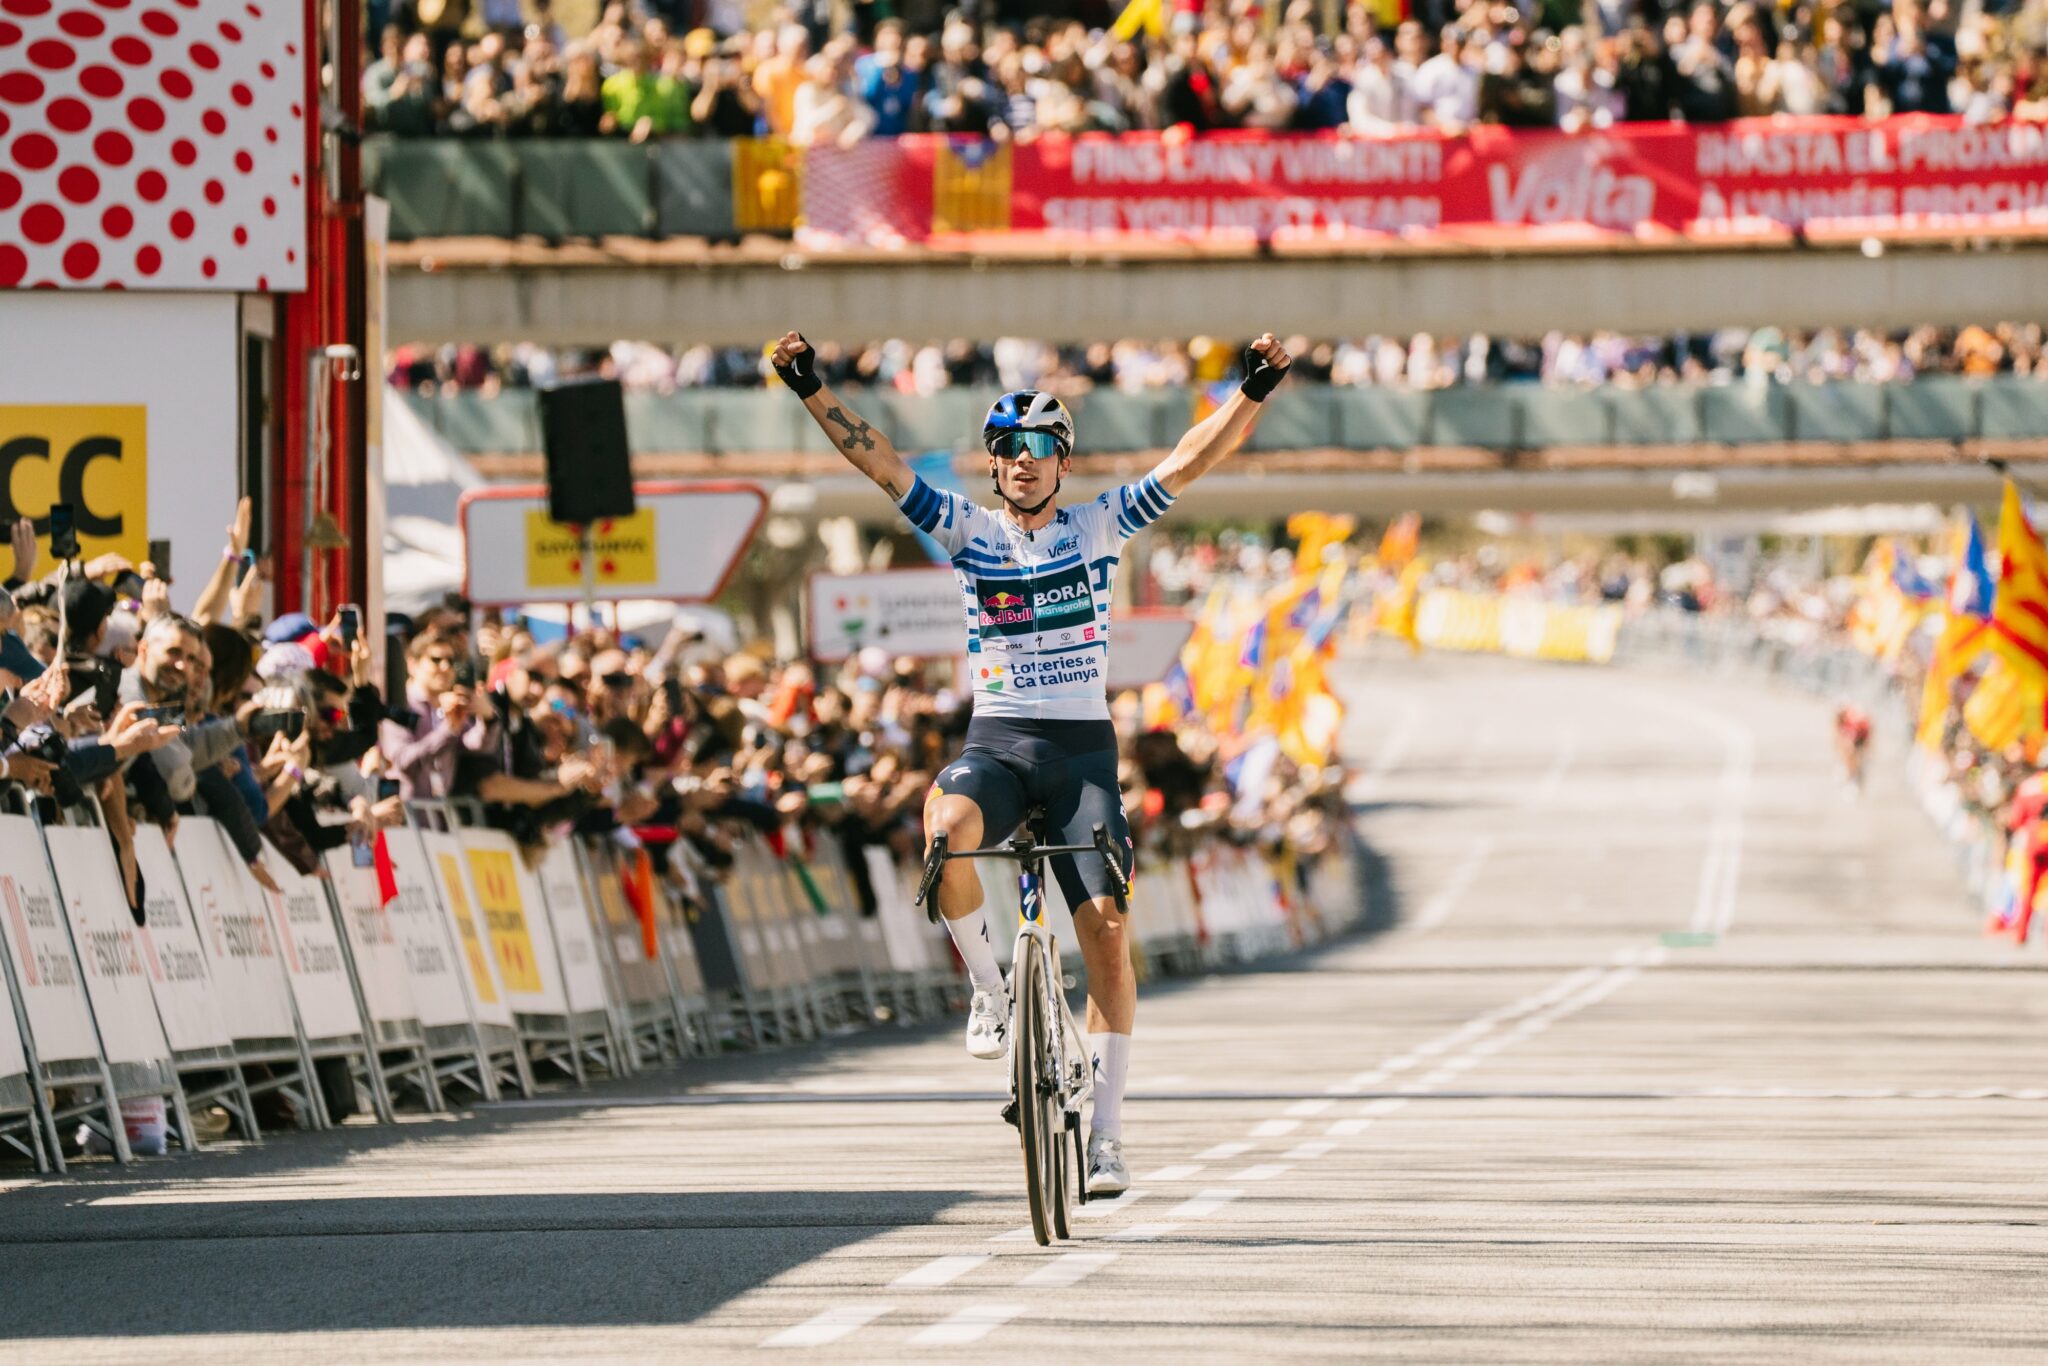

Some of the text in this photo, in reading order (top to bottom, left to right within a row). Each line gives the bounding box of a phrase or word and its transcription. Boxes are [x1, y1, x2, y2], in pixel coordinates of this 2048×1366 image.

[1489, 158, 1656, 229] Volta
[1033, 581, 1089, 606] BORA
[980, 610, 1003, 625] Red
[1005, 607, 1033, 623] Bull
[1036, 599, 1090, 617] hansgrohe
[1085, 656, 1096, 665] de
